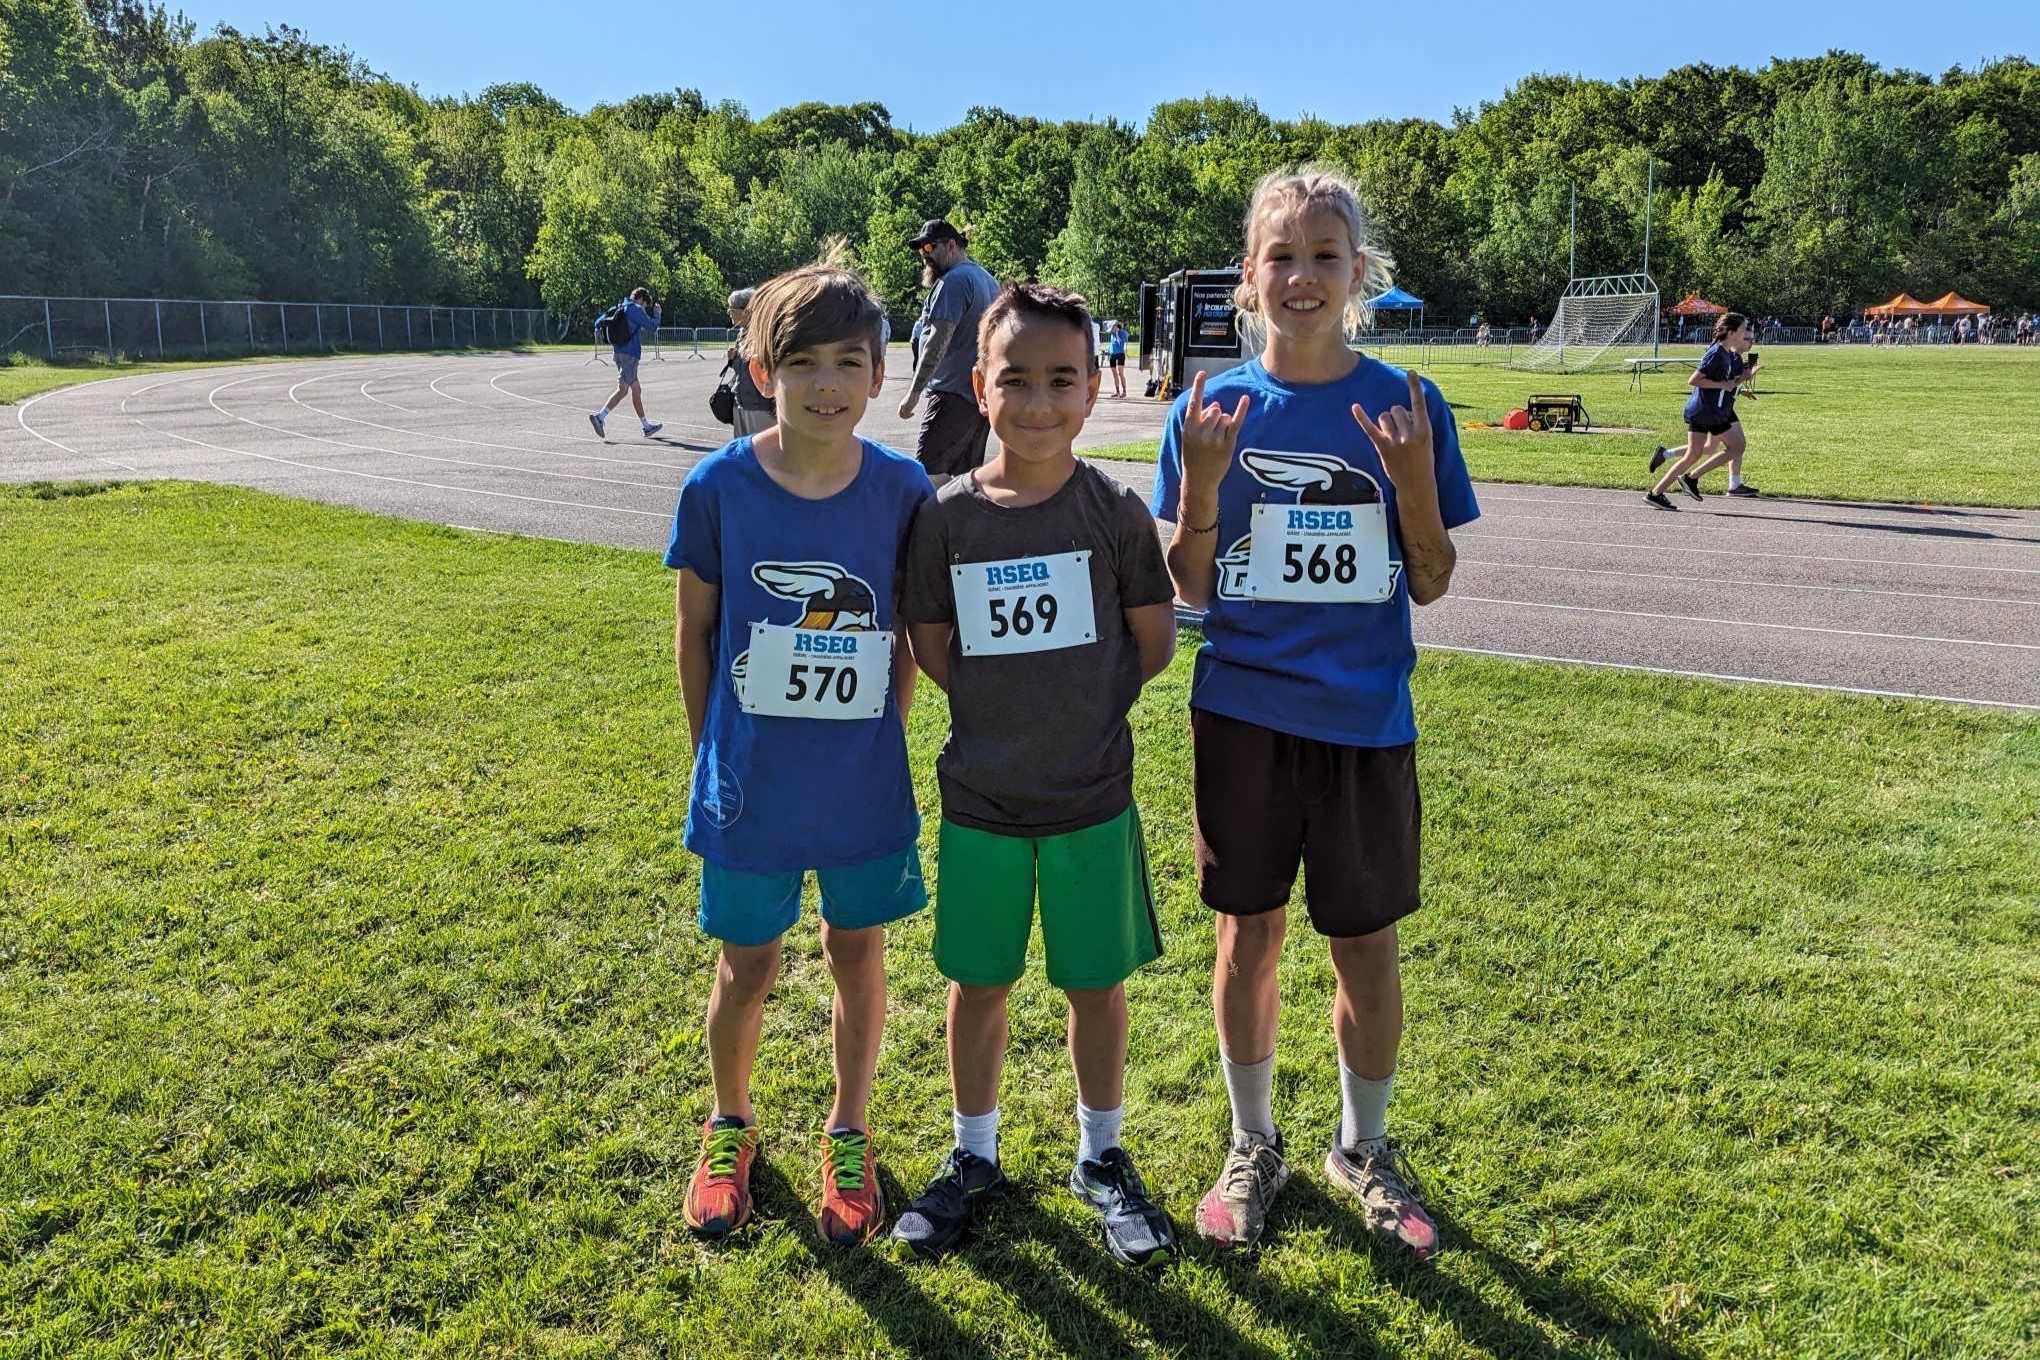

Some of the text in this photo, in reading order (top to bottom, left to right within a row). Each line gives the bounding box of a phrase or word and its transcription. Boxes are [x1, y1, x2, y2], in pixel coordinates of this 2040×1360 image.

[1287, 509, 1354, 530] RSEQ
[985, 561, 1051, 586] RSEQ
[1283, 543, 1357, 584] 568
[988, 593, 1058, 638] 569
[793, 633, 858, 654] RSEQ
[785, 664, 858, 704] 570
